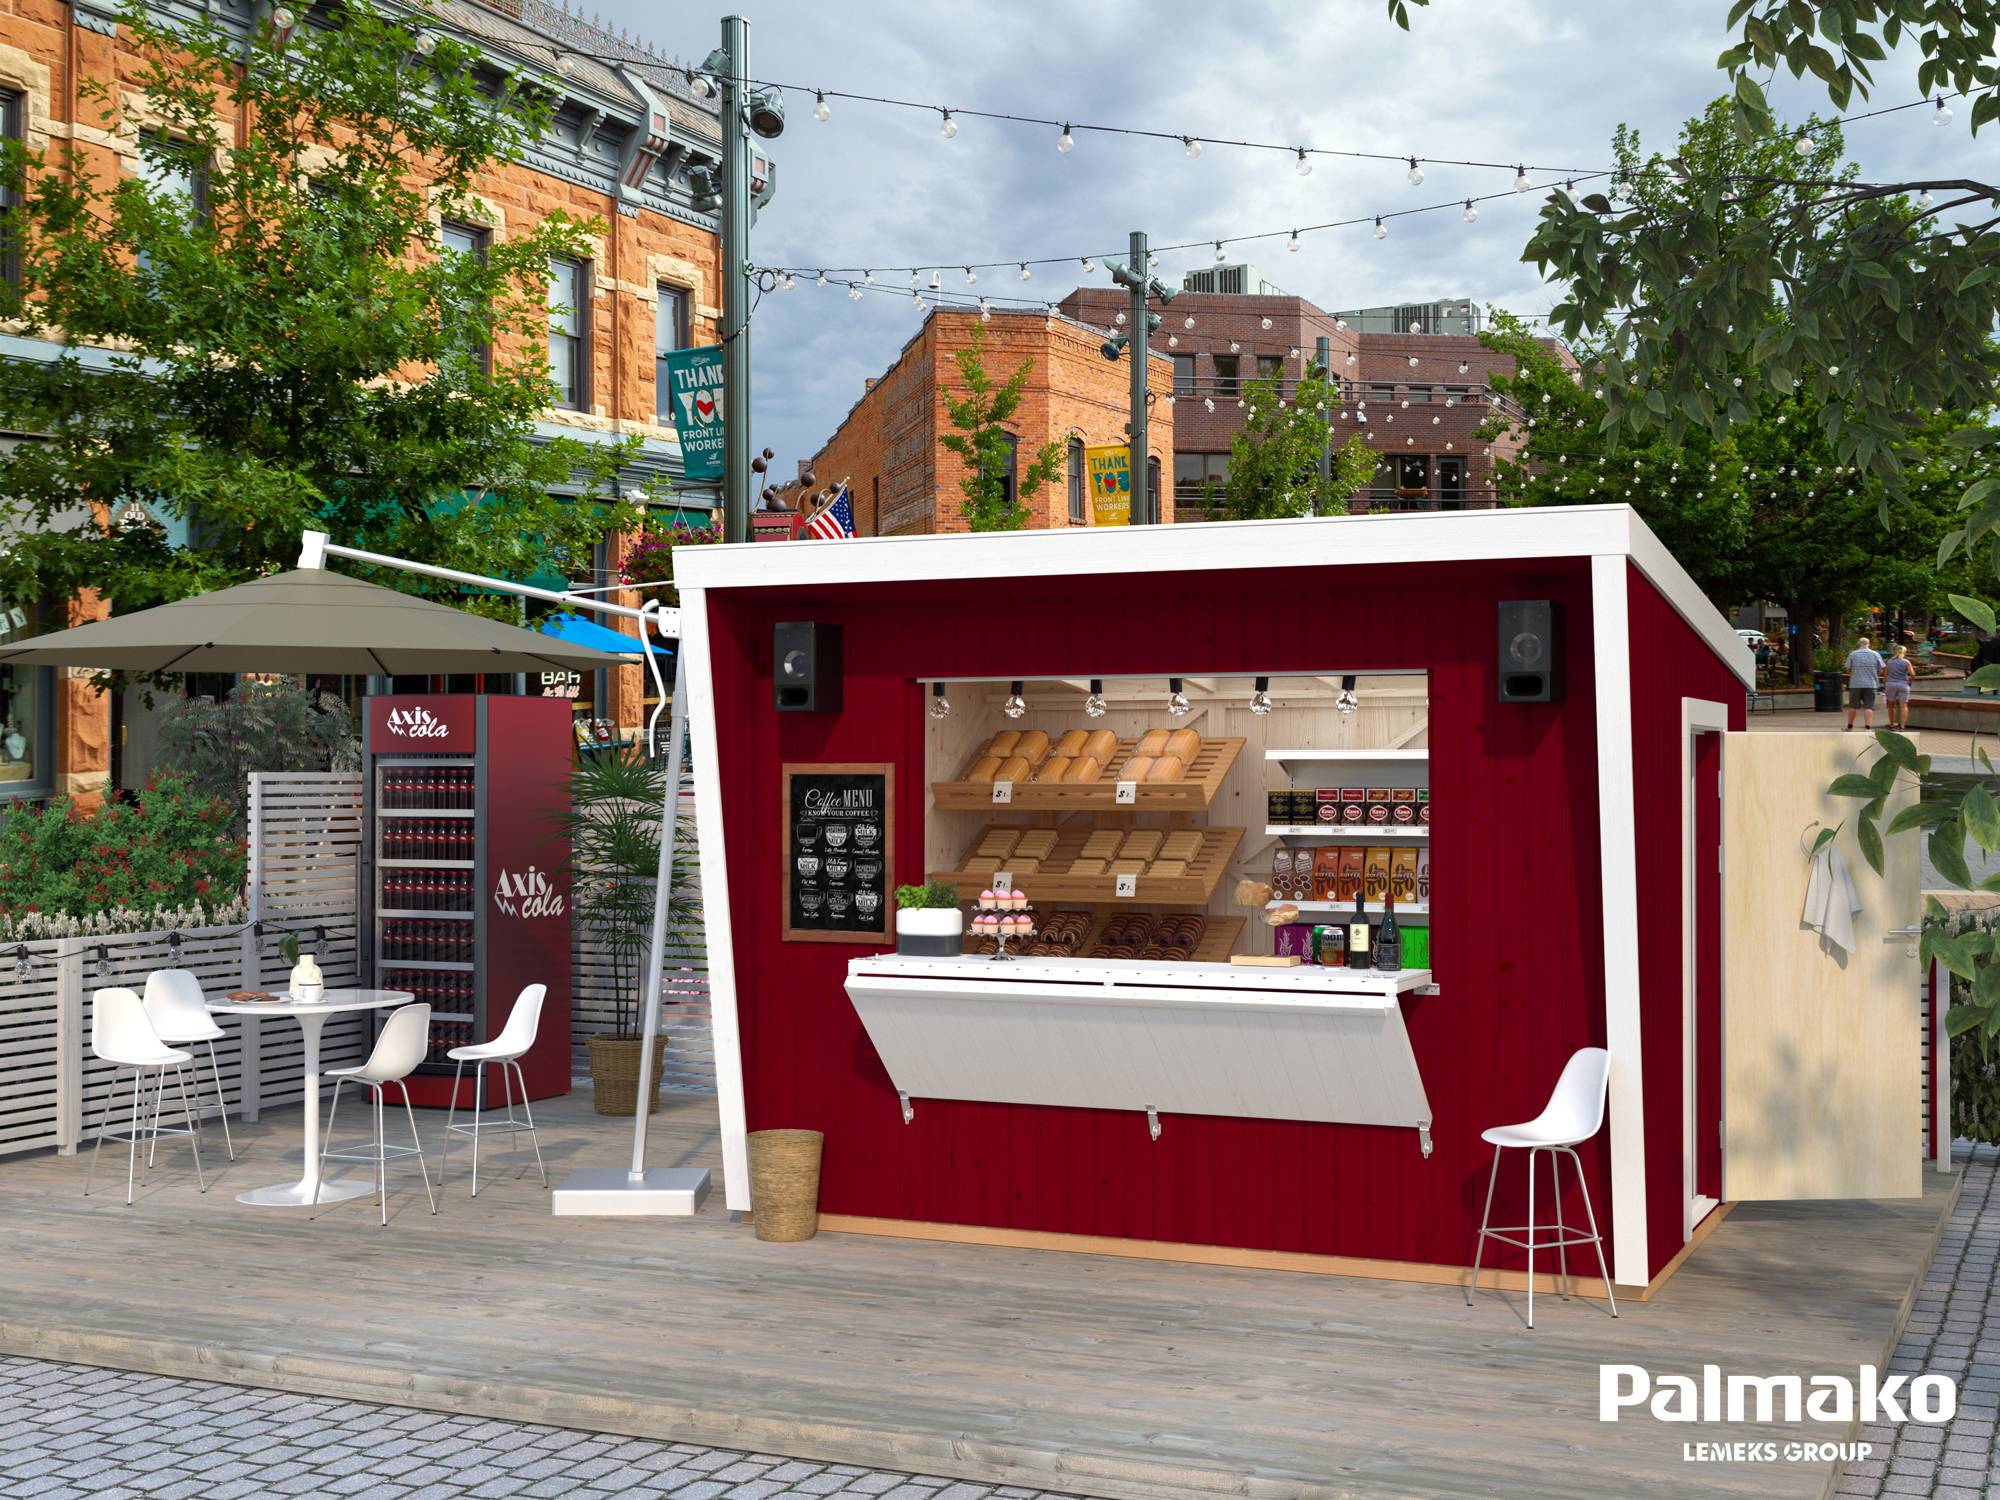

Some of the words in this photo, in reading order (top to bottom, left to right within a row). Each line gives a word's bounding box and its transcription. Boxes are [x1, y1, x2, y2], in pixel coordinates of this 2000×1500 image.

[682, 427, 714, 440] FRONT
[1090, 455, 1128, 470] THANK
[387, 706, 432, 725] Axis
[409, 717, 450, 738] cola
[804, 788, 841, 813] Coffee
[843, 789, 873, 808] MENU
[494, 865, 546, 898] Axis
[521, 883, 565, 919] cola
